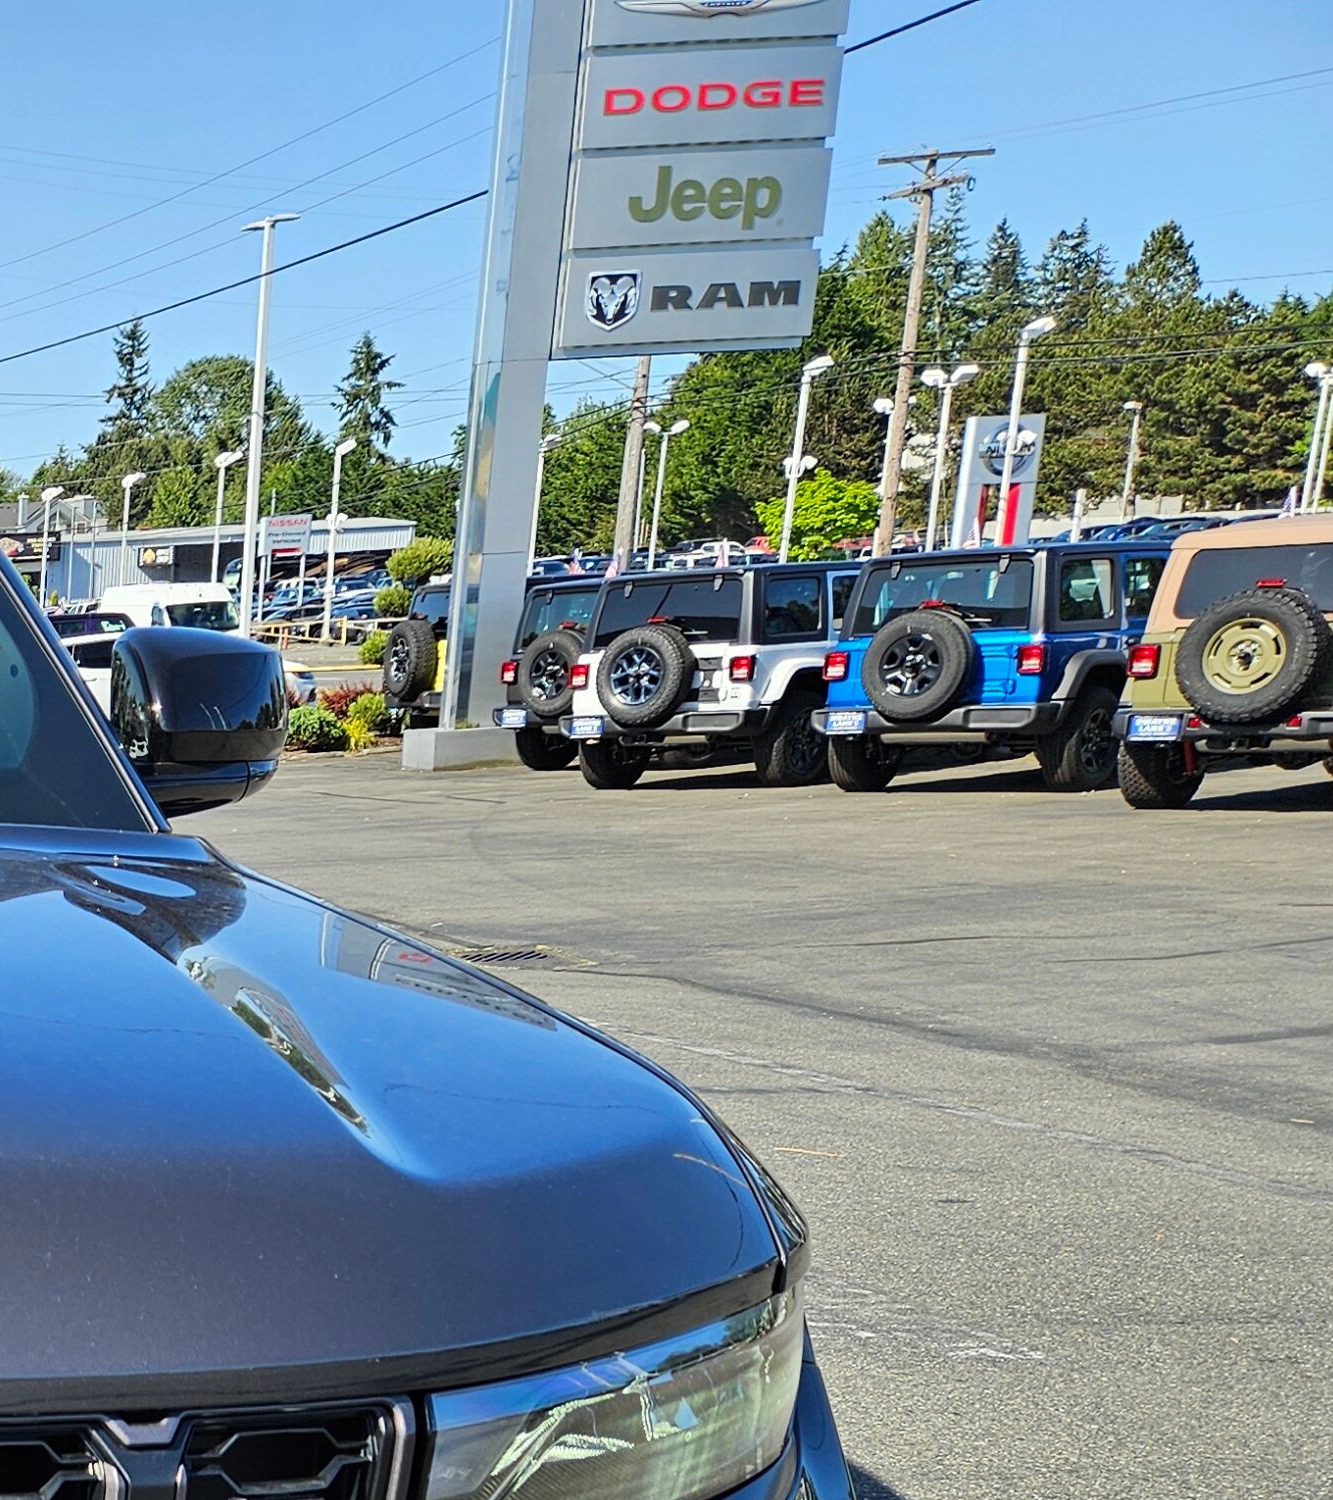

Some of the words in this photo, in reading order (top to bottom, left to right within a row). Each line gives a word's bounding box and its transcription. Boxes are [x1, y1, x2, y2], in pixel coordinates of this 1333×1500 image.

[603, 79, 825, 116] DODGE
[628, 165, 783, 231] Jeep
[650, 279, 802, 312] RAM
